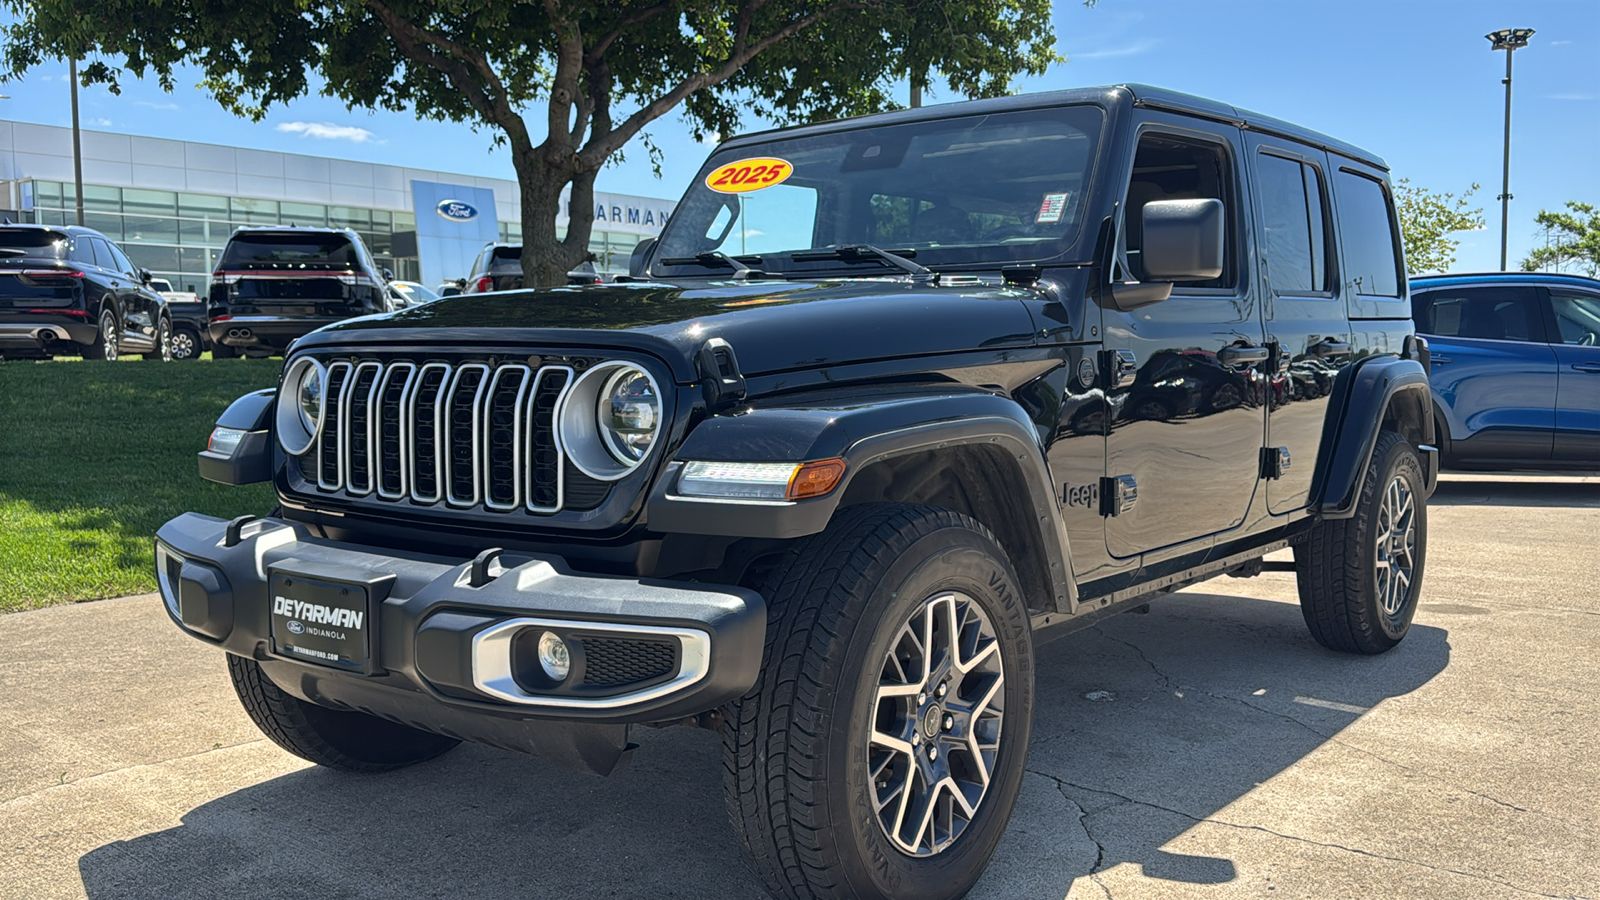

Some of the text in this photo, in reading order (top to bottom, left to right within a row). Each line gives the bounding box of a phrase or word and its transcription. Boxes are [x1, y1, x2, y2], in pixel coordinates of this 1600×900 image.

[713, 164, 786, 186] 2025
[447, 203, 471, 217] Ford
[564, 200, 671, 226] ARMAN
[1059, 482, 1097, 509] Jeep
[274, 596, 363, 630] DEYARMAN
[305, 626, 346, 640] INDIANOLA
